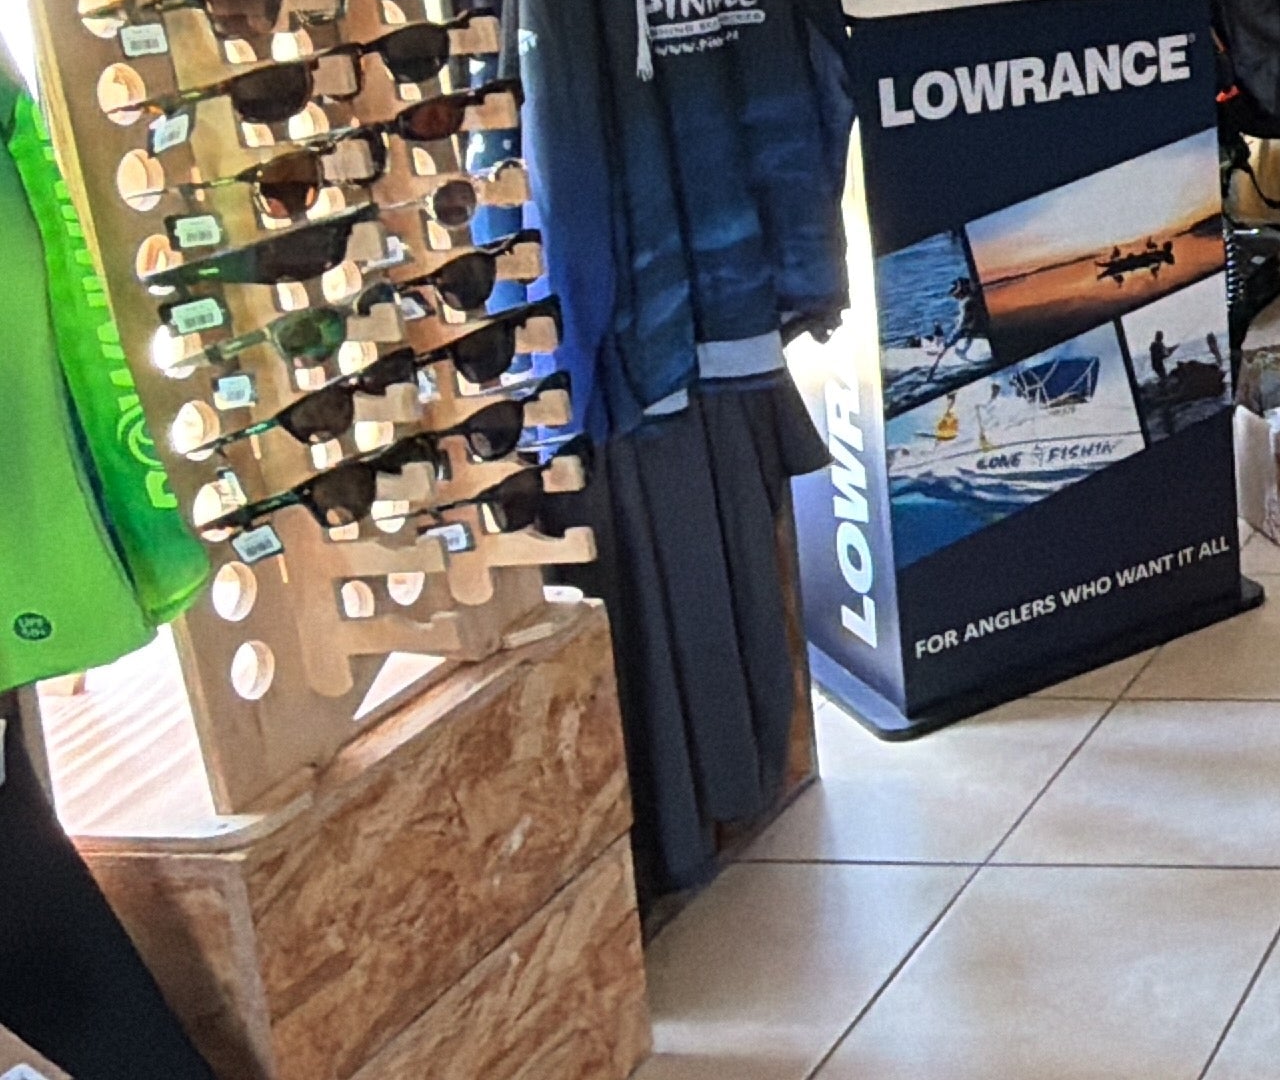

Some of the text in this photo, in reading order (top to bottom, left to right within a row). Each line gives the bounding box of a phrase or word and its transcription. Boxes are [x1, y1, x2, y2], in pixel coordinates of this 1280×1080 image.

[879, 37, 1190, 127] LOWRANCE
[825, 375, 878, 649] LOWR
[915, 535, 1231, 660] FOR ANGLERS WHO WANT IT ALL
